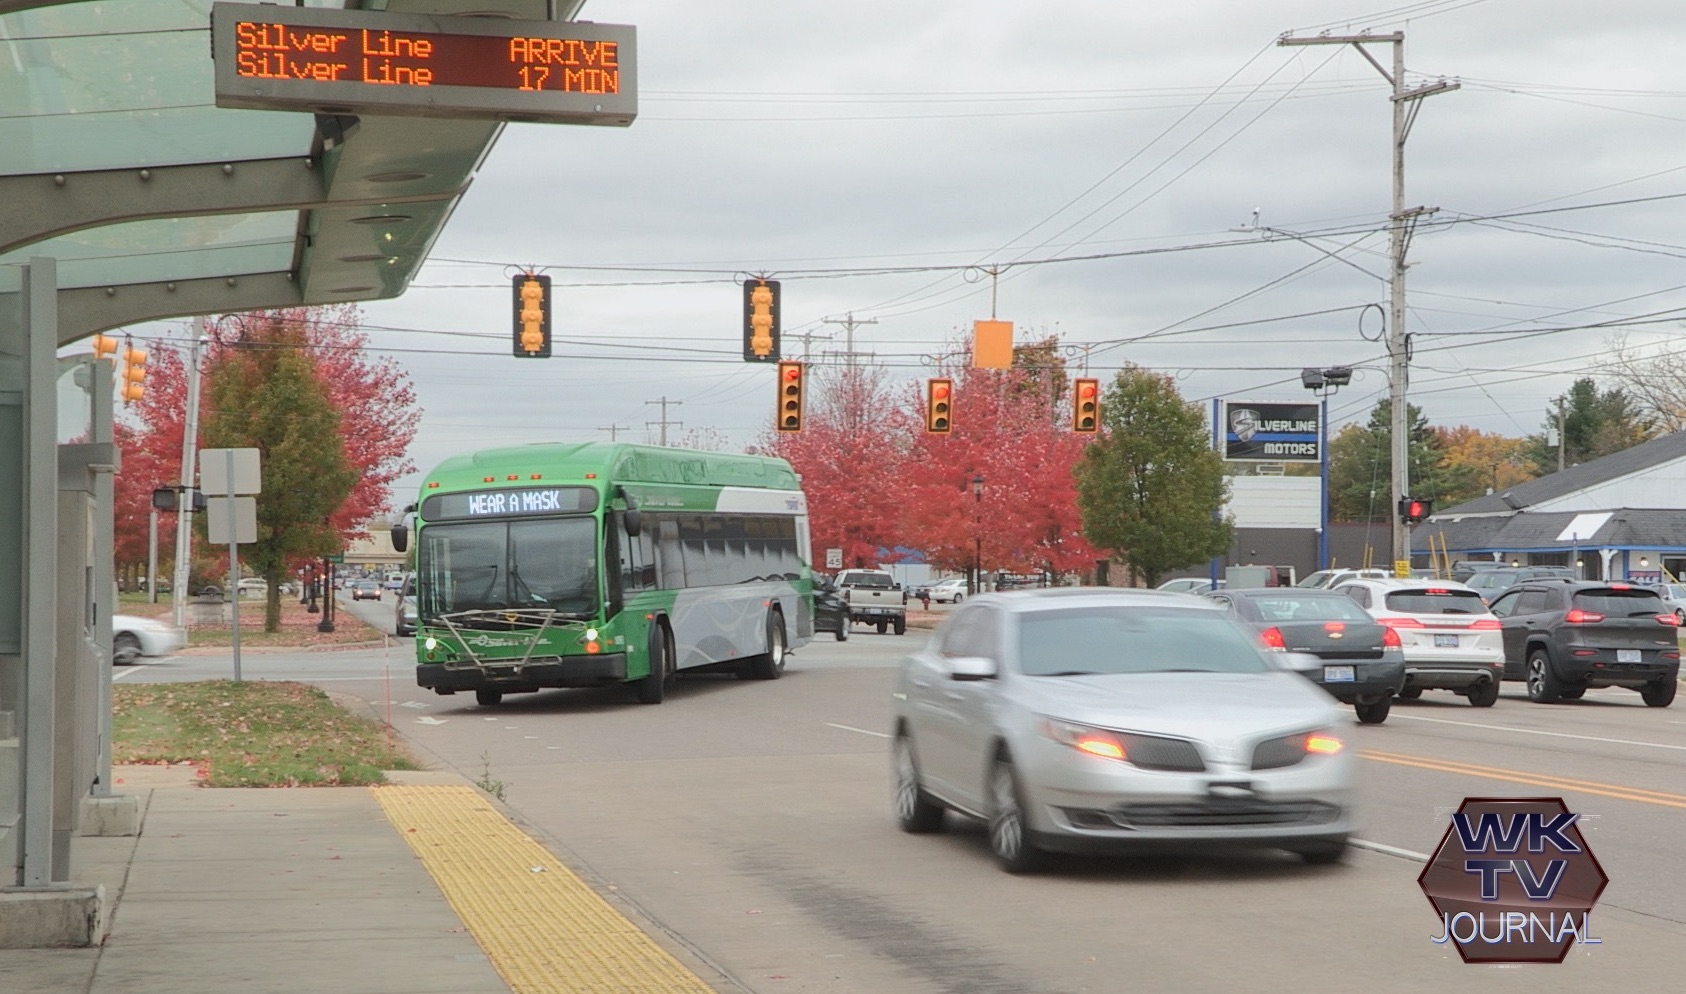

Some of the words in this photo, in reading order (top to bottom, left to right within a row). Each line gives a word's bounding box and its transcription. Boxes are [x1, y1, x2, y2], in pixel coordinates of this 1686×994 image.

[237, 22, 347, 53] Silver
[362, 29, 432, 58] Line
[510, 37, 618, 67] ARRIVE
[238, 51, 347, 81] Silver
[363, 57, 432, 86] Line
[518, 66, 549, 91] 17
[565, 68, 619, 94] MIN
[1264, 443, 1316, 455] MOTORS
[469, 493, 506, 515] WEAR
[509, 493, 520, 512] A
[522, 490, 560, 511] MASK
[828, 558, 841, 566] 45
